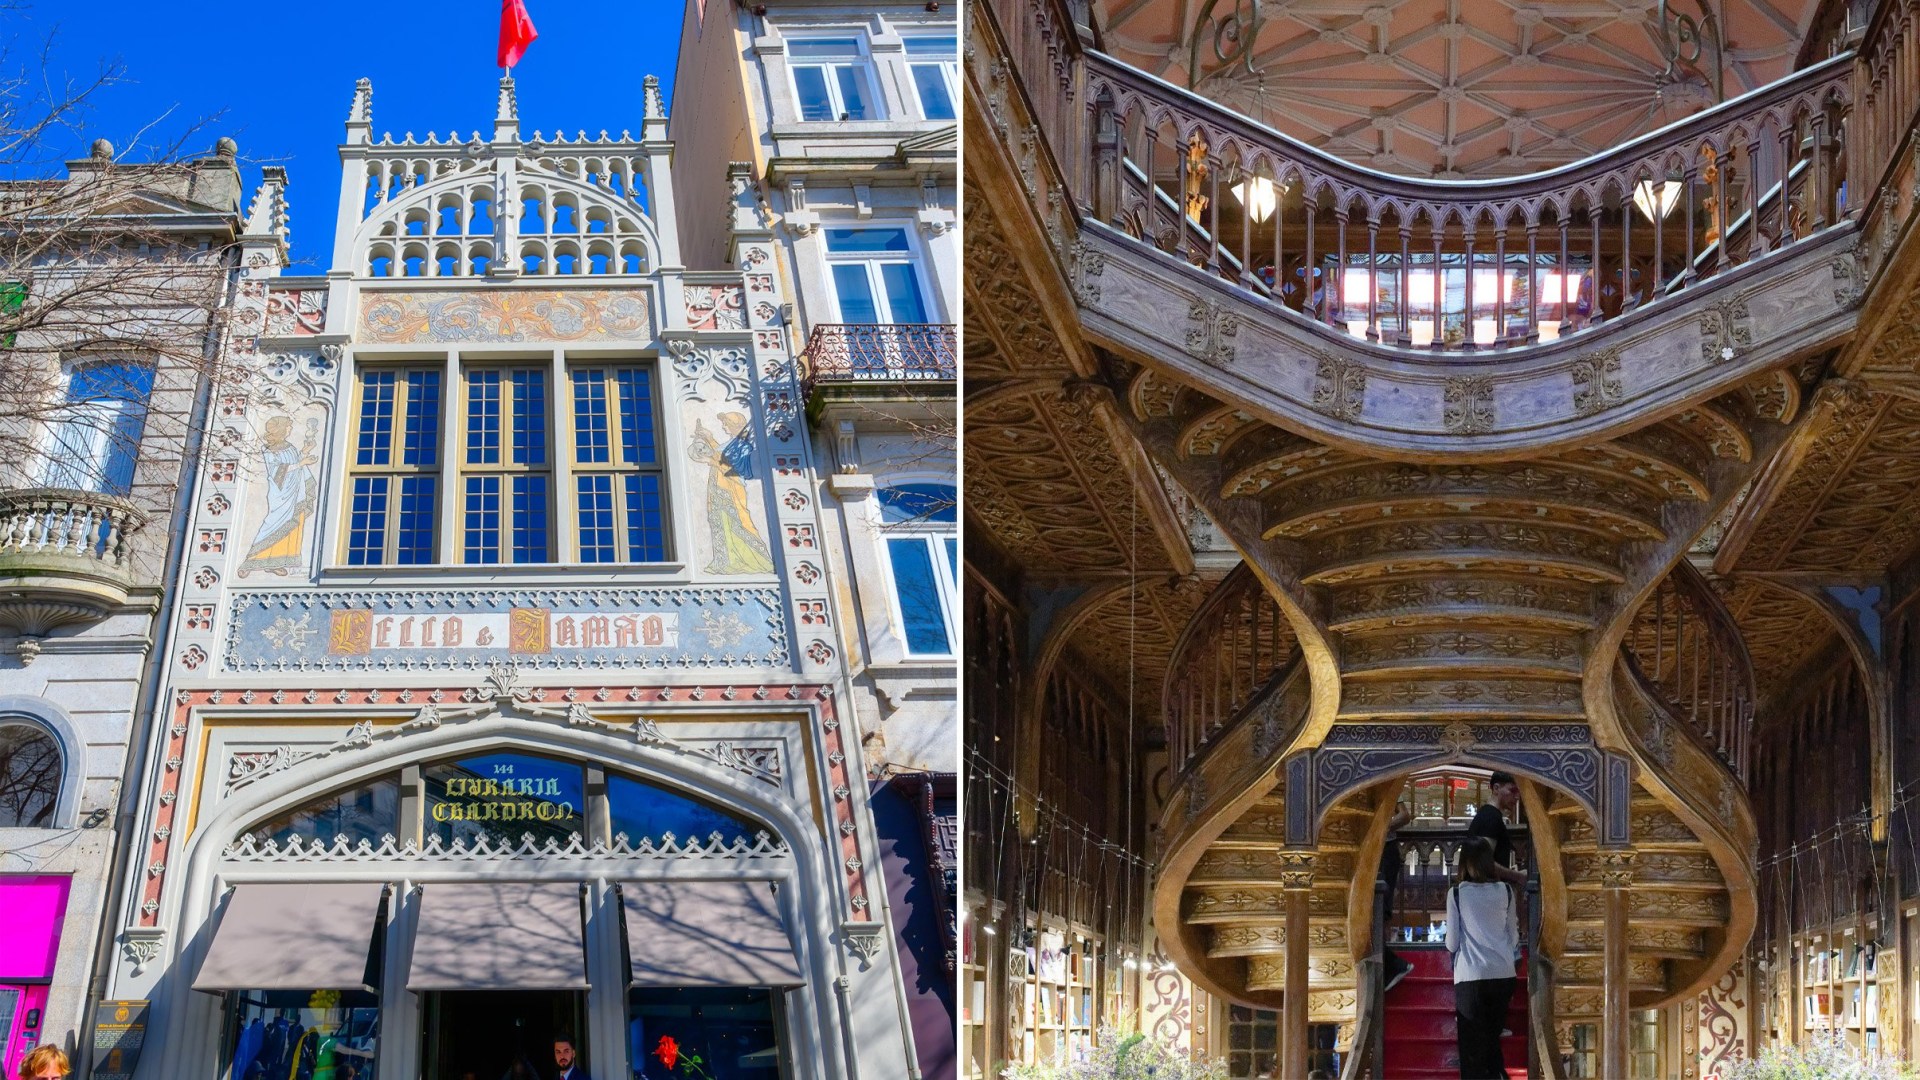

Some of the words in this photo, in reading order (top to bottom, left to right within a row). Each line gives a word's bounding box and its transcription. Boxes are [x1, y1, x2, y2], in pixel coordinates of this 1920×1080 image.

[331, 610, 463, 654] LELLO
[475, 625, 495, 646] &
[493, 764, 515, 774] 144
[445, 777, 562, 797] LIVRARIA
[432, 801, 574, 822] CHARDRON
